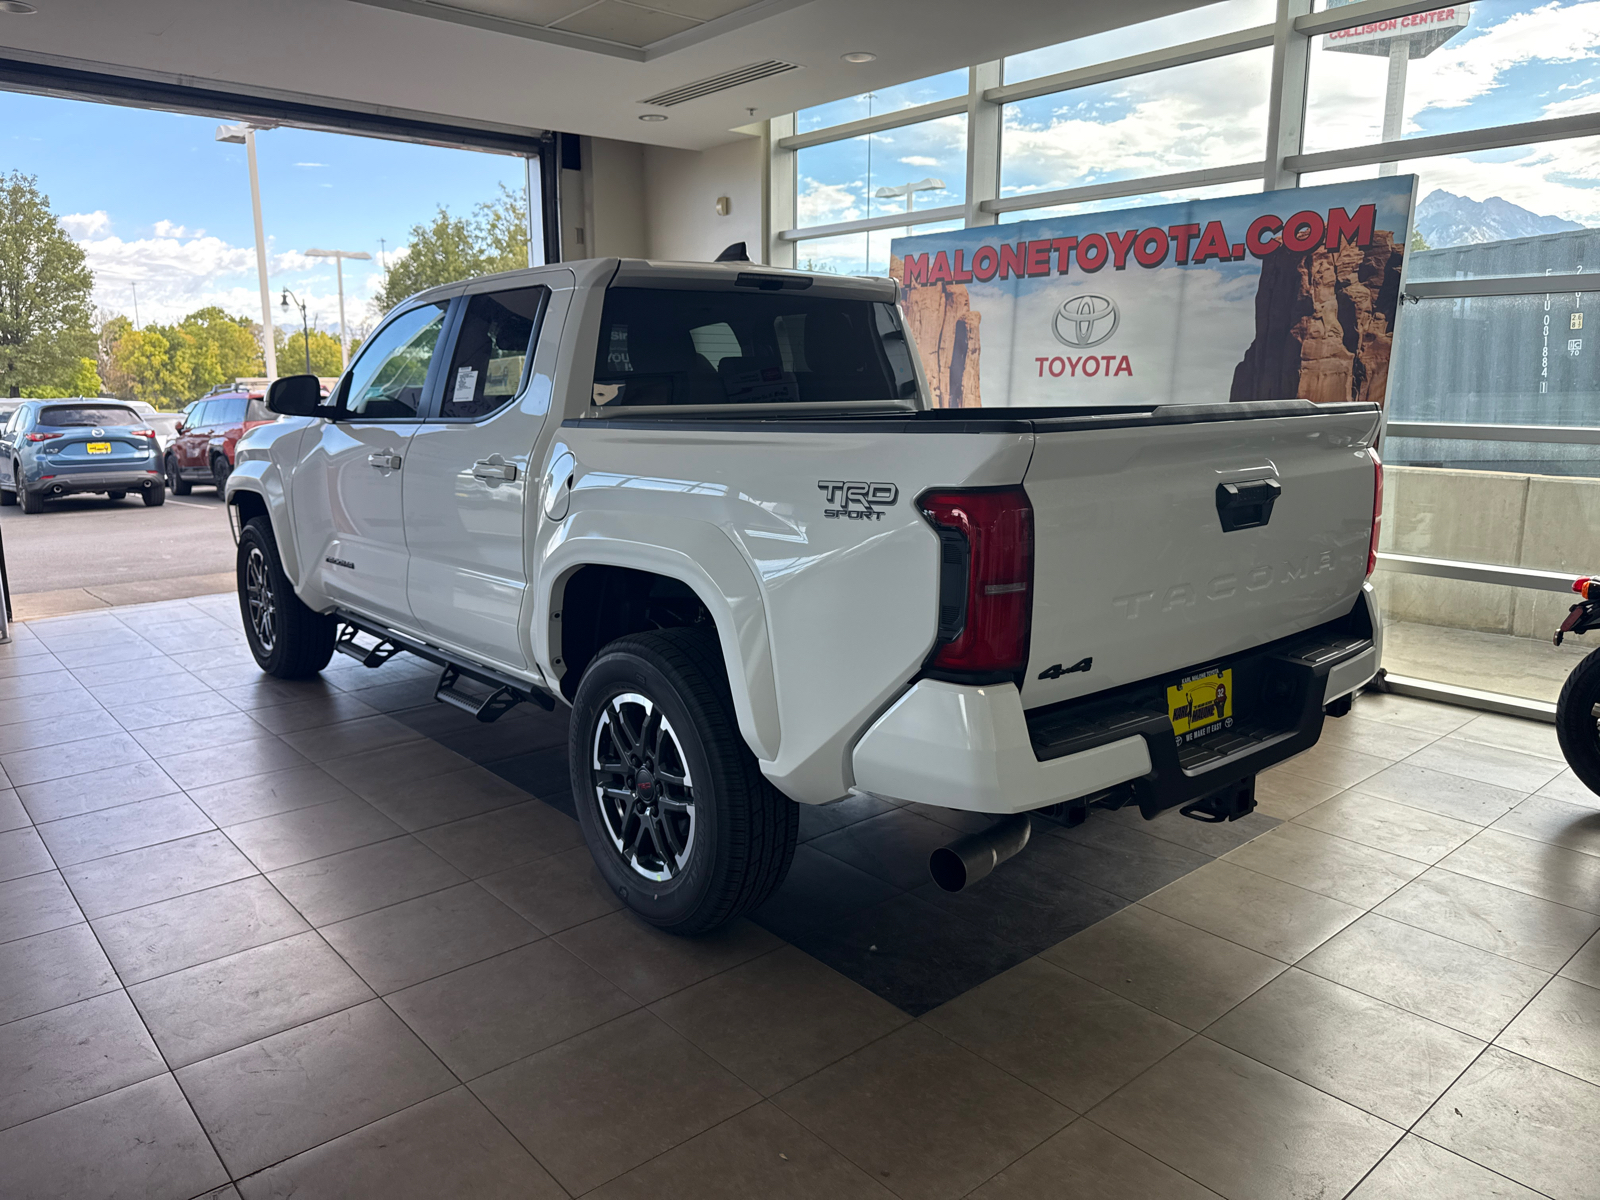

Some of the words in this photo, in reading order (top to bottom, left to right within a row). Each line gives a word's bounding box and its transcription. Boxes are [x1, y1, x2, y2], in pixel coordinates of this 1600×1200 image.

[1329, 20, 1397, 40] COLLISION
[1401, 8, 1455, 28] CENTER
[904, 203, 1376, 287] MALONETOYOTA.COM
[1035, 355, 1133, 378] TOYOTA
[818, 480, 899, 511] TRD
[823, 509, 886, 521] SPORT
[1112, 549, 1335, 620] TACOMA
[1217, 688, 1225, 698] 32
[1185, 732, 1193, 742] WE
[1193, 727, 1206, 740] MAKE
[1206, 725, 1211, 735] IT
[1211, 722, 1222, 733] EASY
